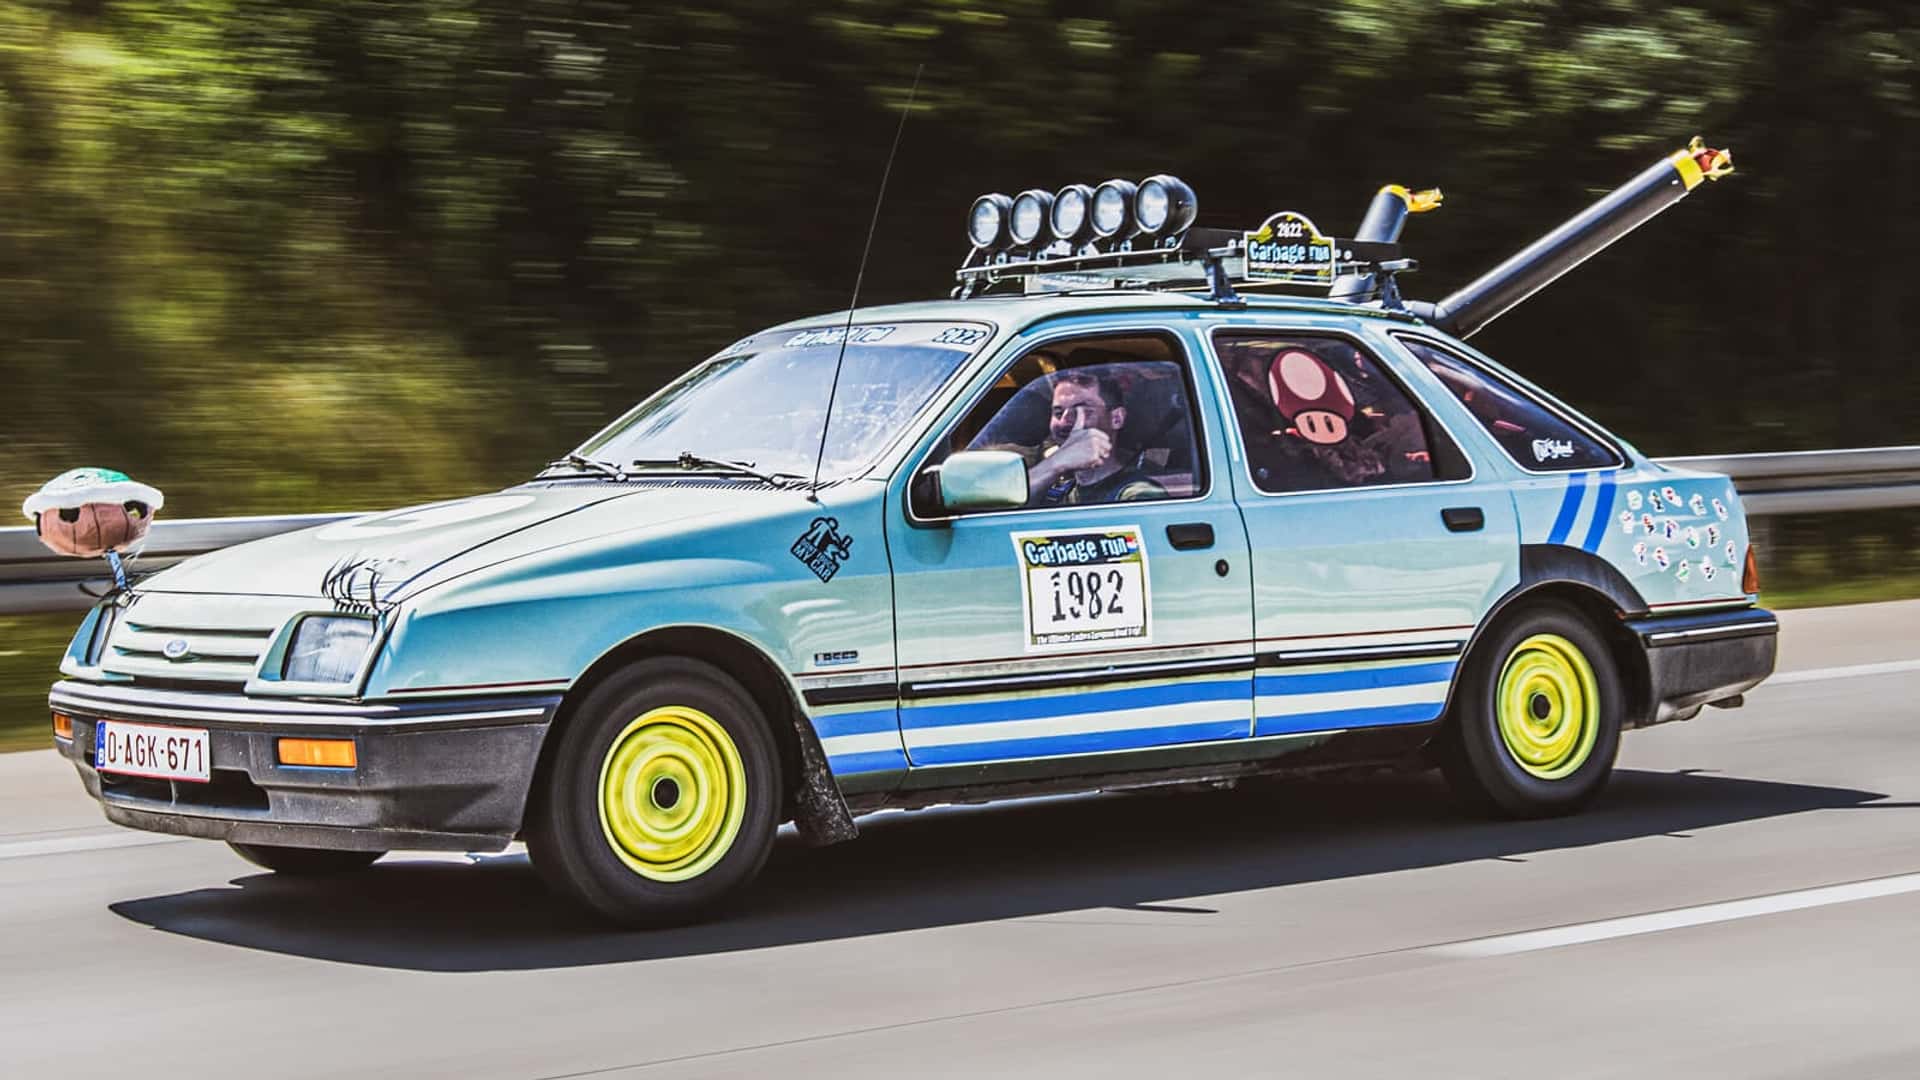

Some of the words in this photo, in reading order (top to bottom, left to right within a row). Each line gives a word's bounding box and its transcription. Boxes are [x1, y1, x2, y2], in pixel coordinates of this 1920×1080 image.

[1277, 222, 1303, 238] 2022
[1248, 241, 1306, 264] Carbage
[1025, 539, 1097, 565] Carbage
[1100, 537, 1128, 555] run
[810, 559, 832, 581] CAR
[1051, 569, 1124, 622] 1982
